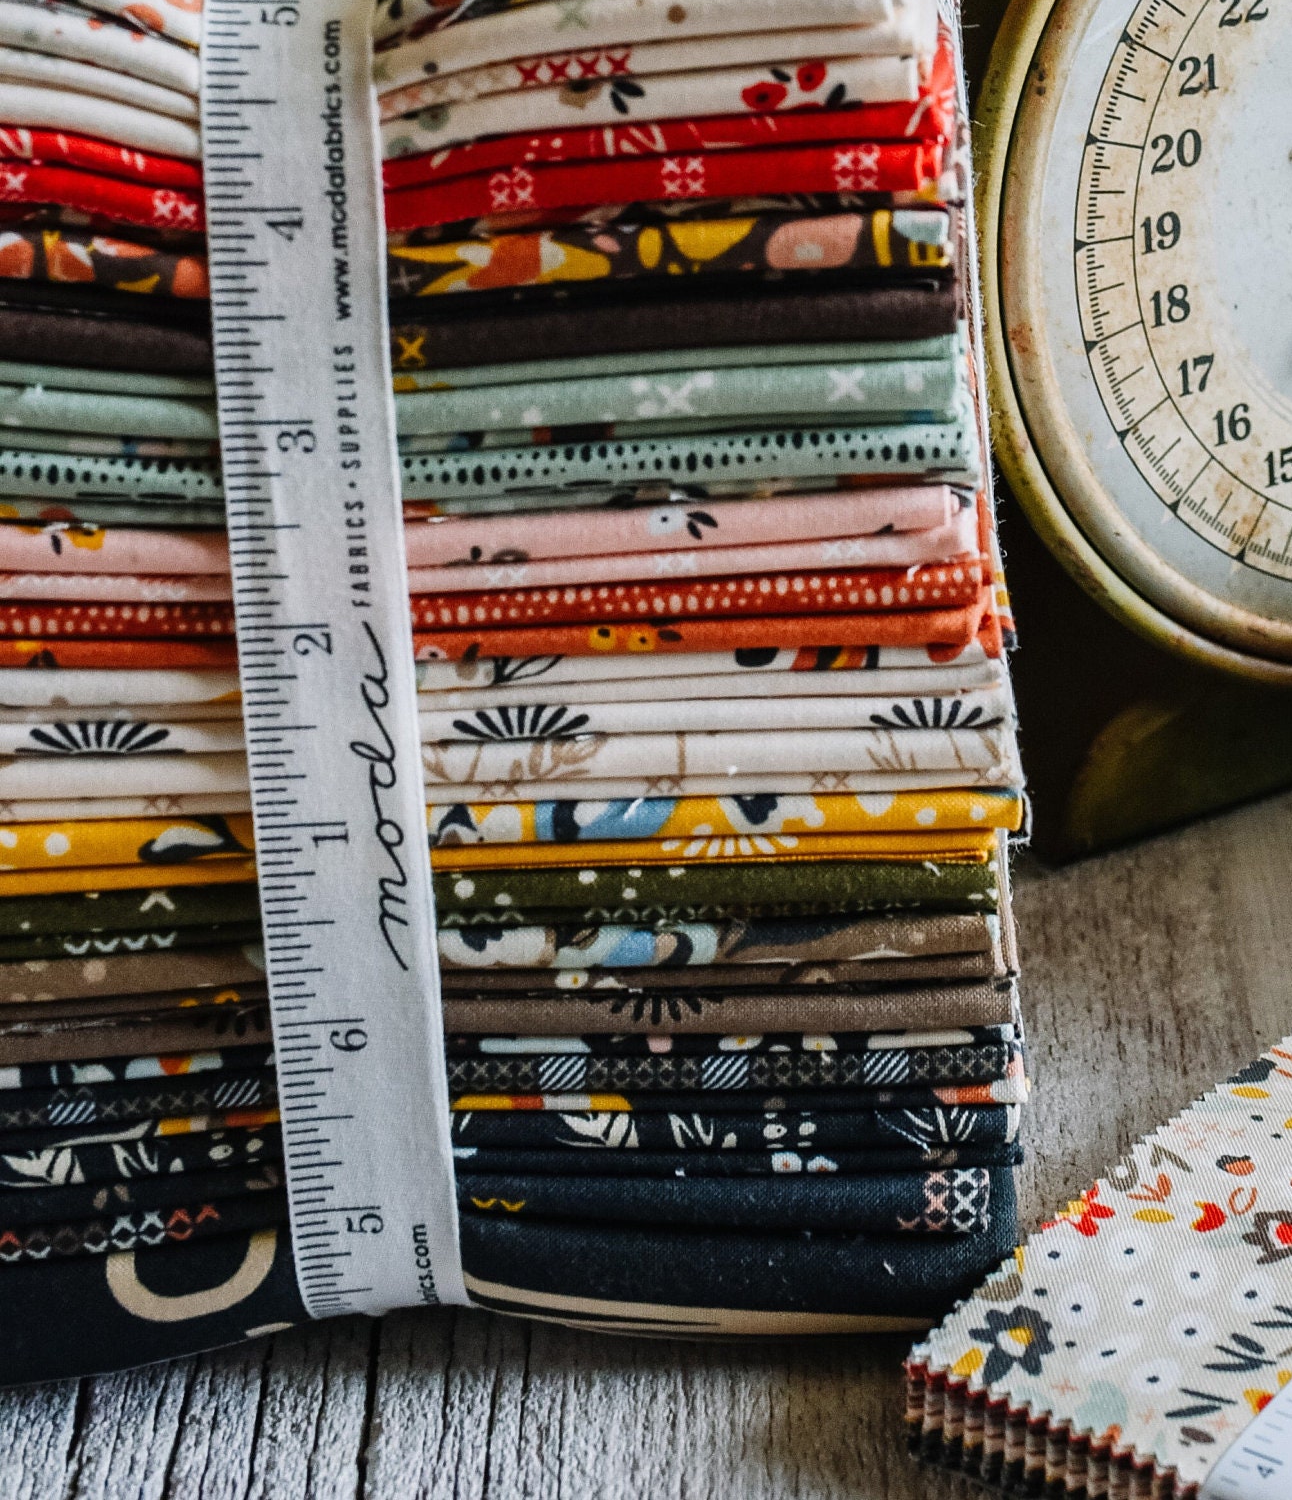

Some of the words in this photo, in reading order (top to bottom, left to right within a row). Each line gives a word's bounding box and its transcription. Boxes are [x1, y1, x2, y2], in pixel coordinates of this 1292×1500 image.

[260, 5, 299, 27] 5
[1176, 53, 1220, 97] 21
[322, 19, 351, 322] www.modafabrics.com
[1149, 128, 1203, 174] 20
[265, 216, 304, 242] 4
[1140, 211, 1181, 253] 19
[1150, 284, 1191, 328] 18
[1176, 353, 1216, 397] 17
[333, 344, 362, 471] SUPPLIES
[1213, 400, 1252, 446] 16
[277, 428, 318, 454] 3
[343, 501, 372, 608] FABRICS
[294, 631, 333, 657] 2
[351, 621, 409, 970] moda
[311, 828, 349, 848] 1
[330, 1028, 368, 1053] 6
[347, 1213, 384, 1236] 5
[1256, 1463, 1275, 1479] 4
